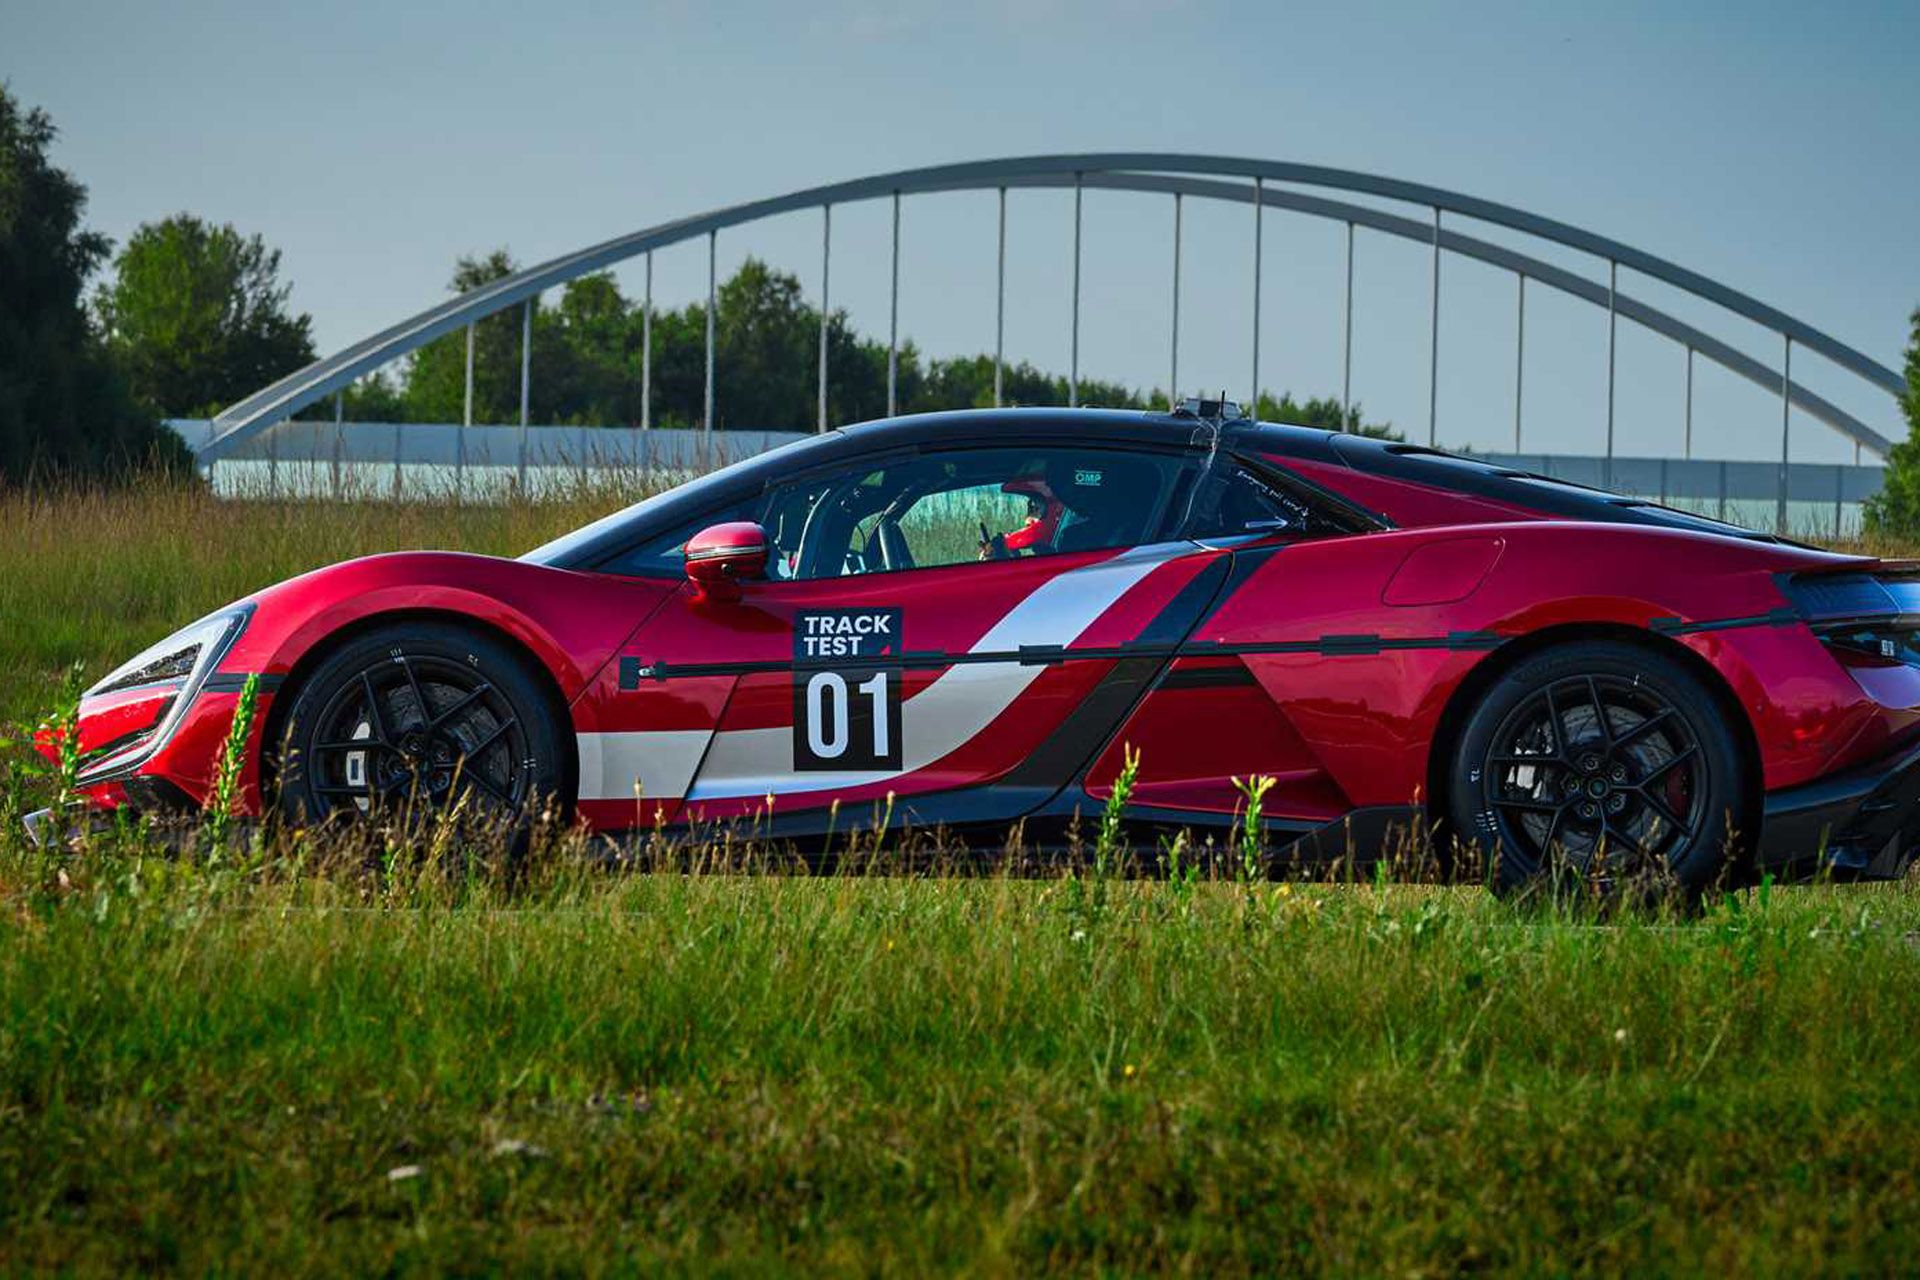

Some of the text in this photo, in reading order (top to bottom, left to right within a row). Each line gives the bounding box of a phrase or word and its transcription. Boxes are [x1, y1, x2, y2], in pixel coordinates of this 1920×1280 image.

[804, 615, 892, 634] TRACK
[804, 636, 863, 656] TEST
[807, 671, 889, 758] 01
